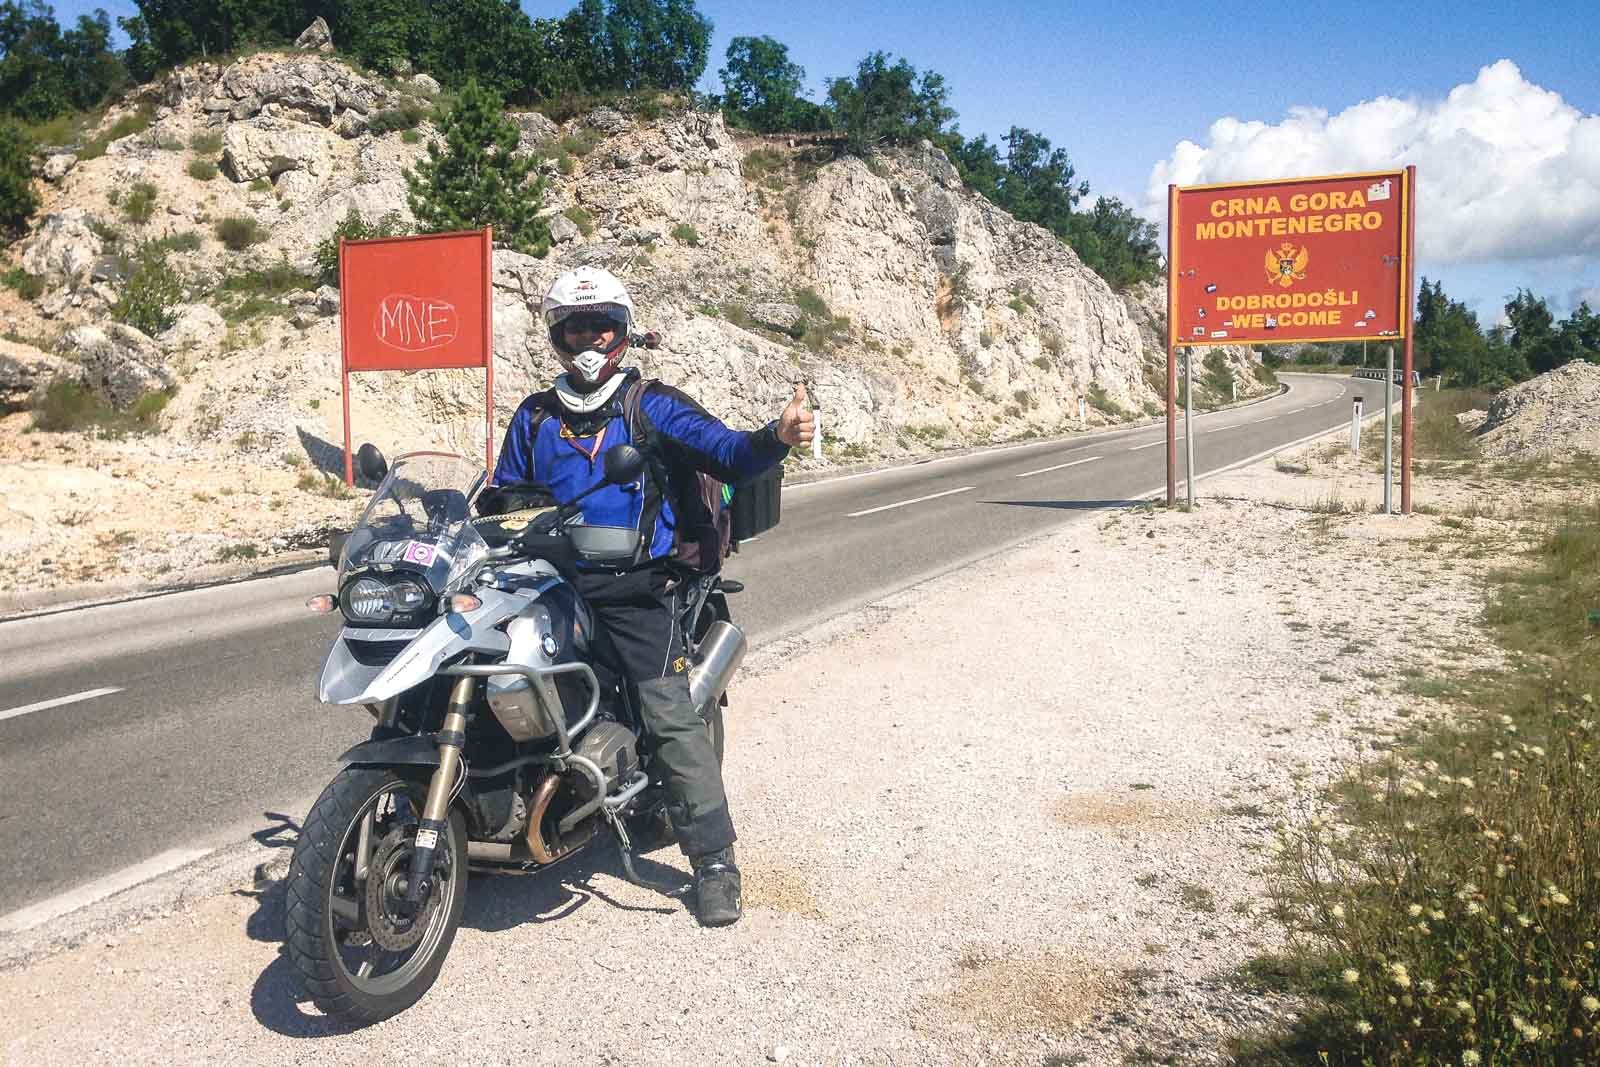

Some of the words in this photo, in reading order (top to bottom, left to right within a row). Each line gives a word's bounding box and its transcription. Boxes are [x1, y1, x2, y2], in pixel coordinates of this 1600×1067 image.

[1210, 196, 1282, 218] CRNA
[1290, 190, 1366, 212] GORA
[1195, 211, 1383, 241] MONTENEGRO
[1216, 288, 1359, 312] DOBRODOŠLI
[380, 299, 454, 345] MNE
